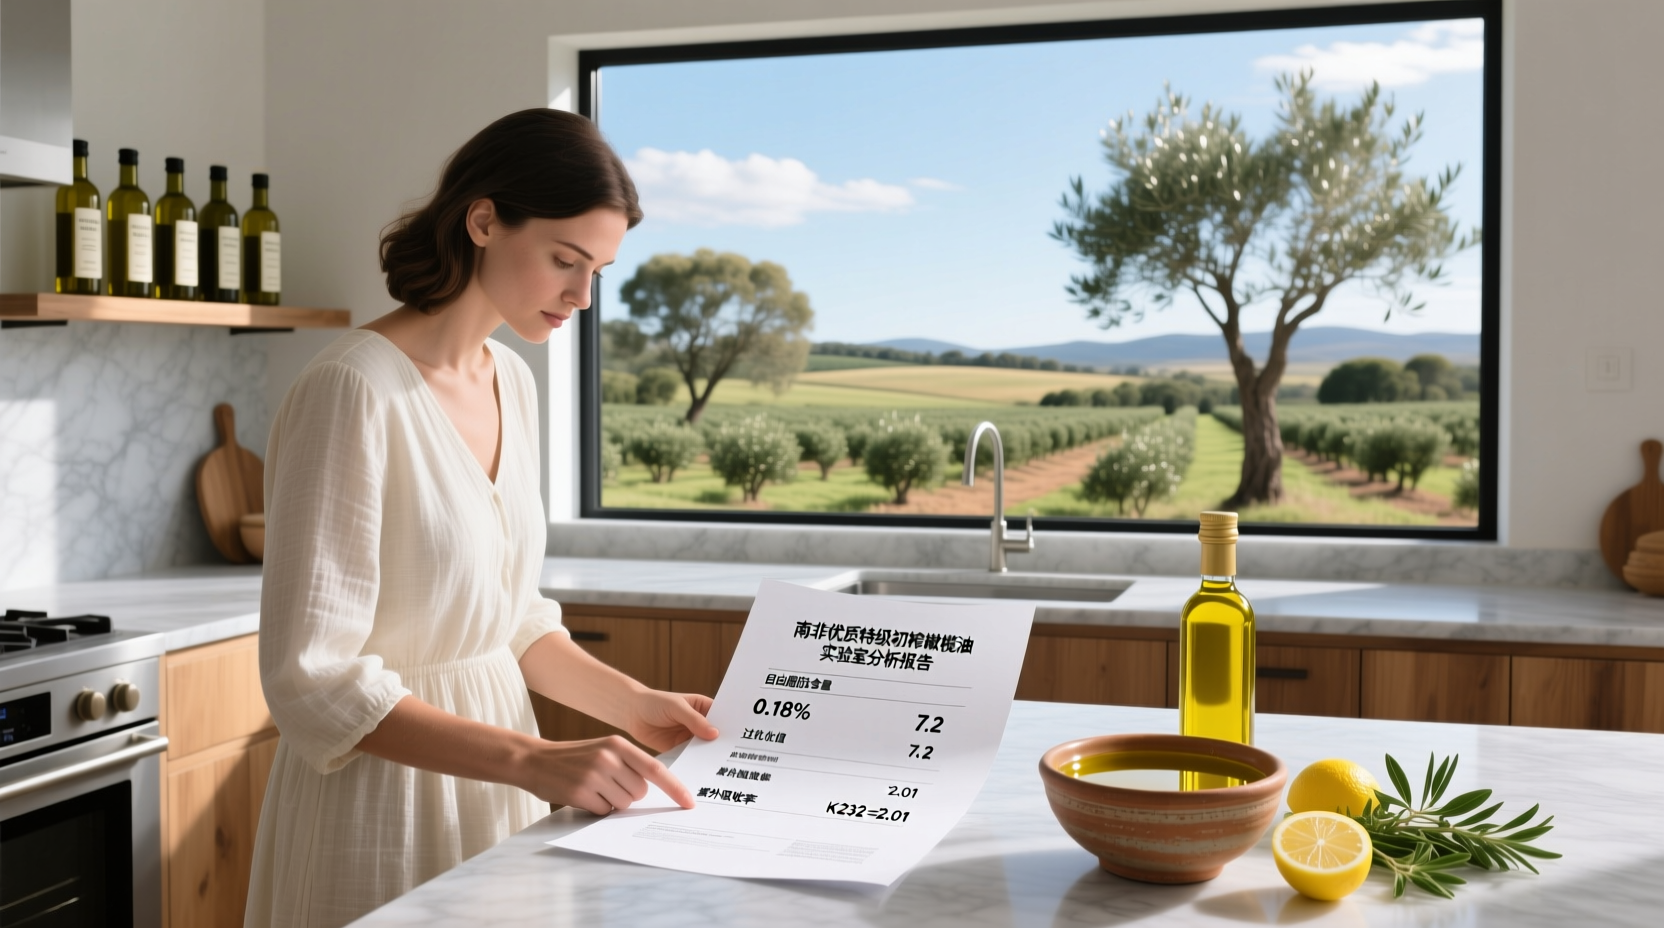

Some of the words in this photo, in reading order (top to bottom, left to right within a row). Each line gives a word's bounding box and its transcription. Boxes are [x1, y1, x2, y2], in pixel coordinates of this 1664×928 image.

[819, 643, 934, 671] 实验室分析报告
[753, 698, 811, 720] 0.18%
[915, 714, 944, 733] 7.2
[908, 744, 934, 760] 7.2
[888, 786, 918, 798] 2.01
[826, 801, 910, 822] K232=2.01
